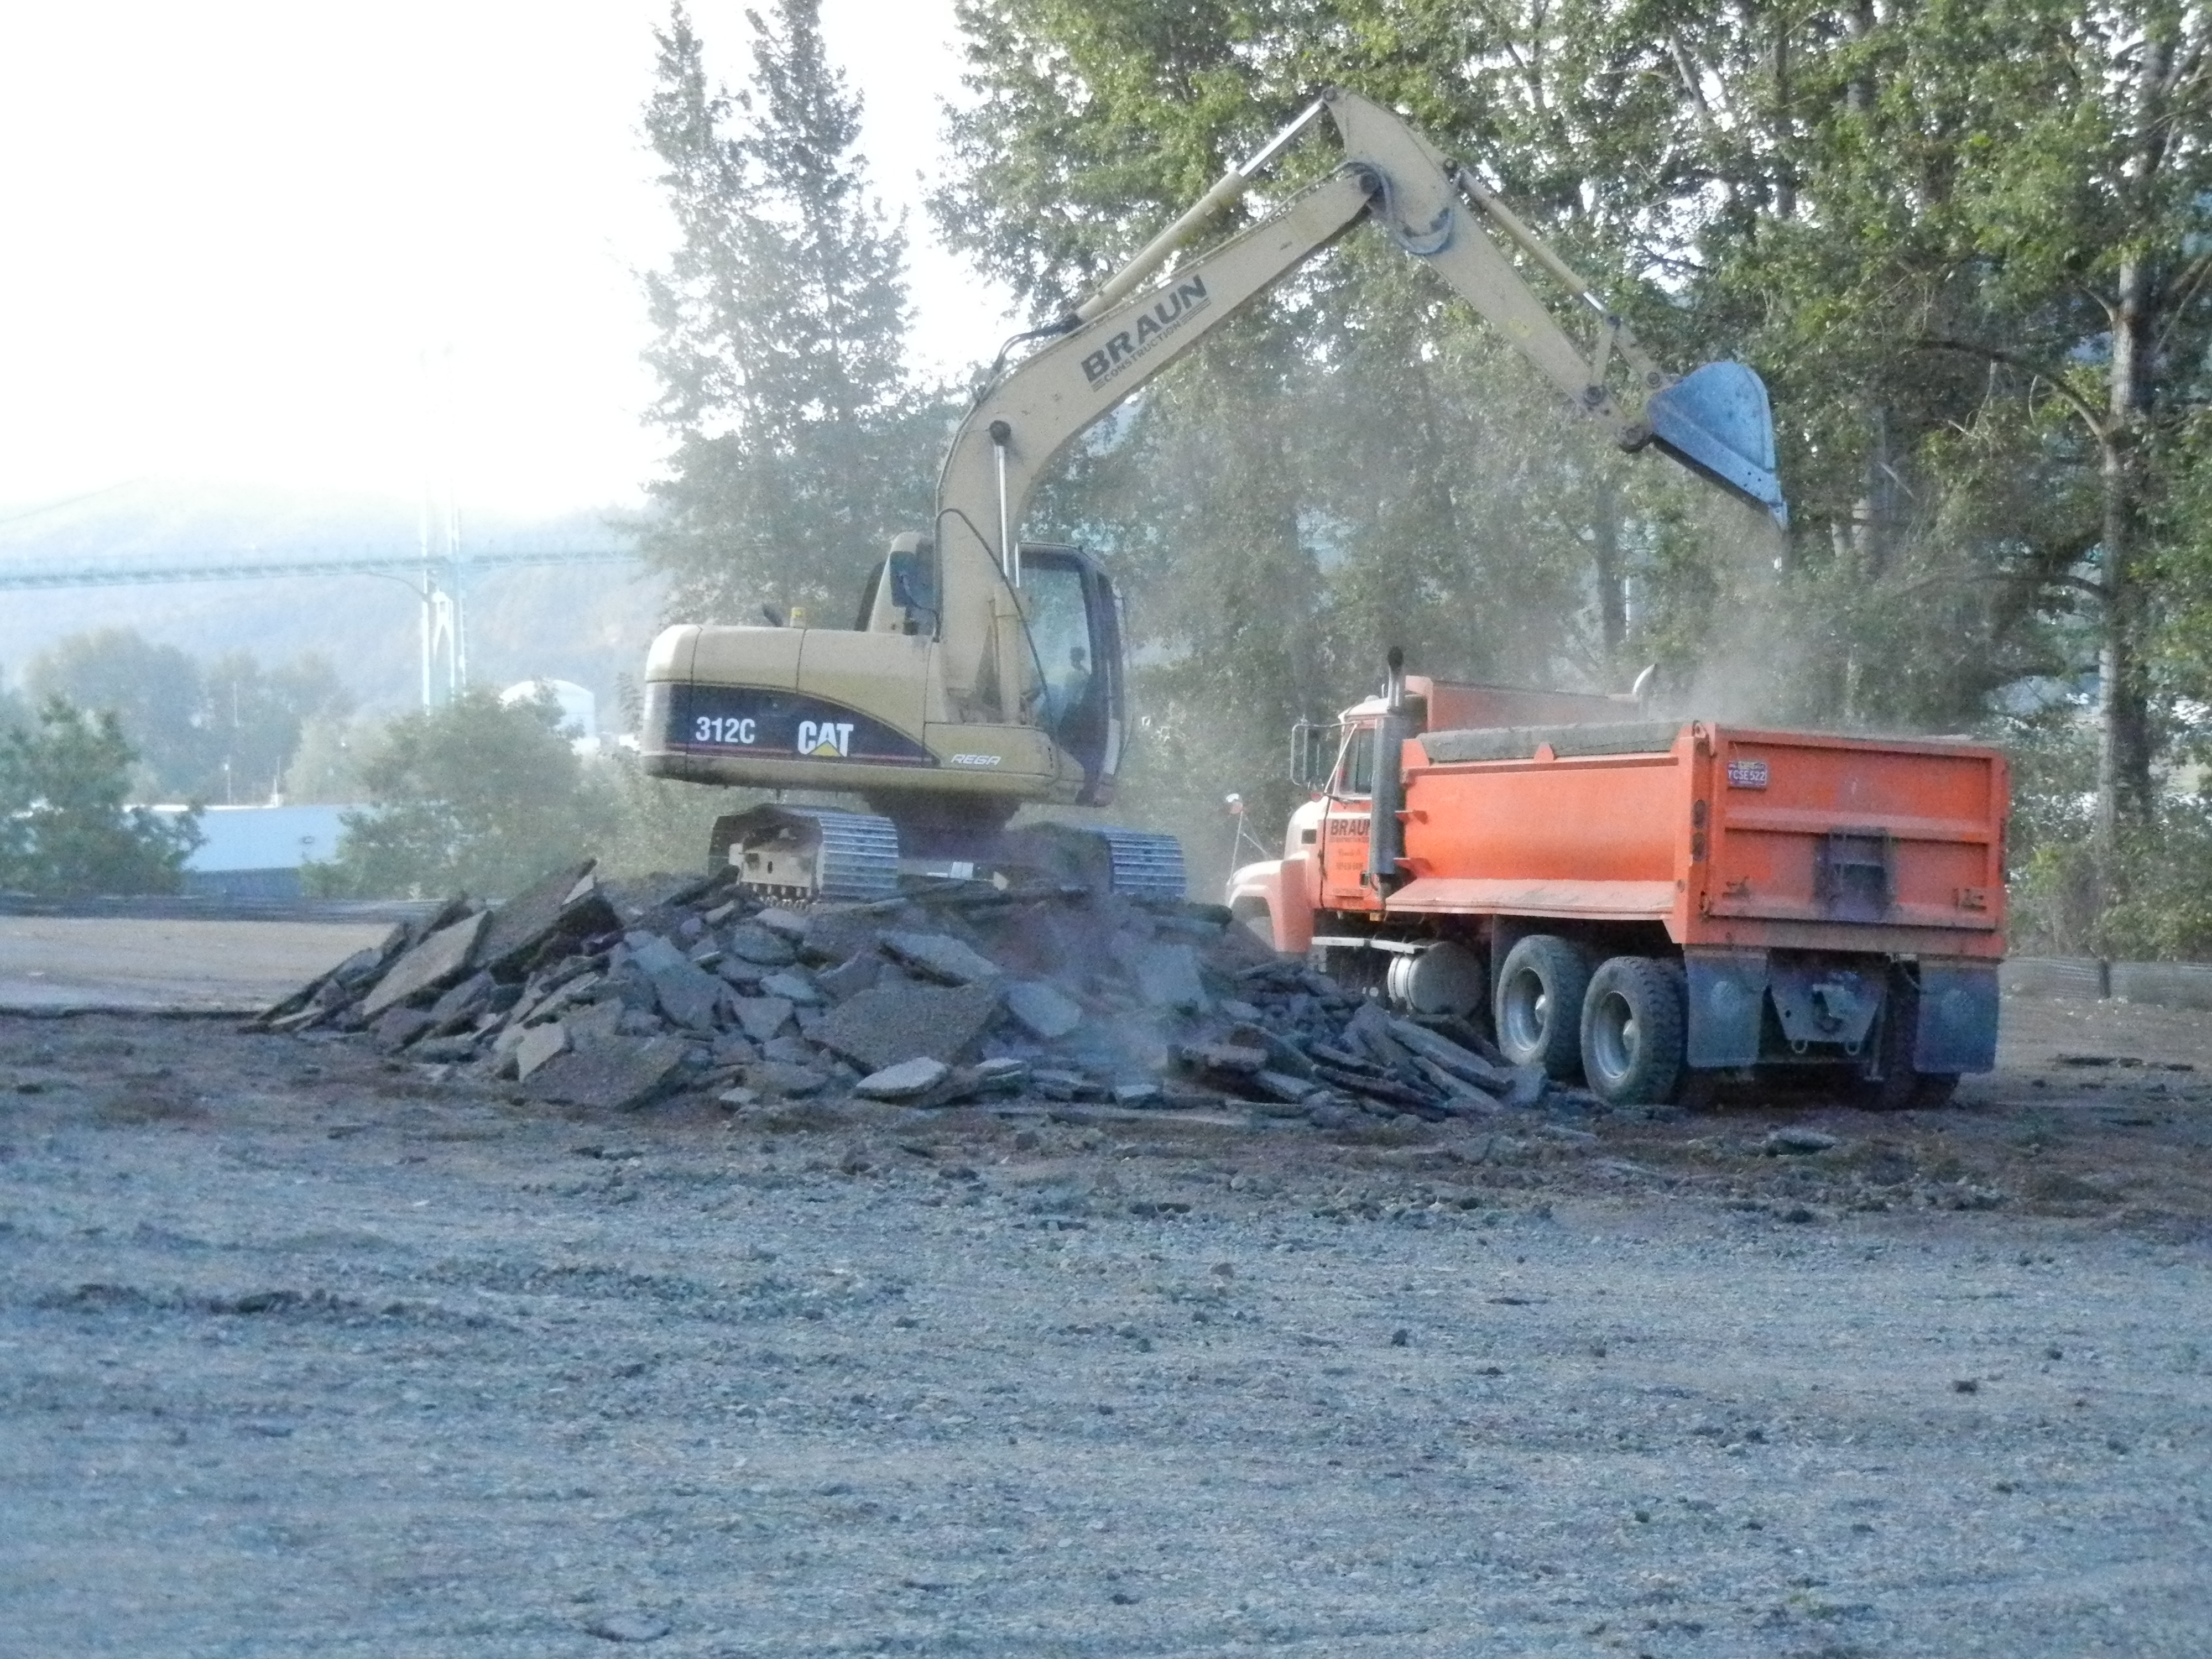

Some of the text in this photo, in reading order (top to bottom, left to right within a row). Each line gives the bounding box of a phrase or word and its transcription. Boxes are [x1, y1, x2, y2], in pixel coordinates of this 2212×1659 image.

[1081, 274, 1207, 383] BRAUN
[1104, 320, 1181, 382] CONSTRUCTION
[696, 716, 755, 744] 312C
[797, 721, 854, 757] CAT
